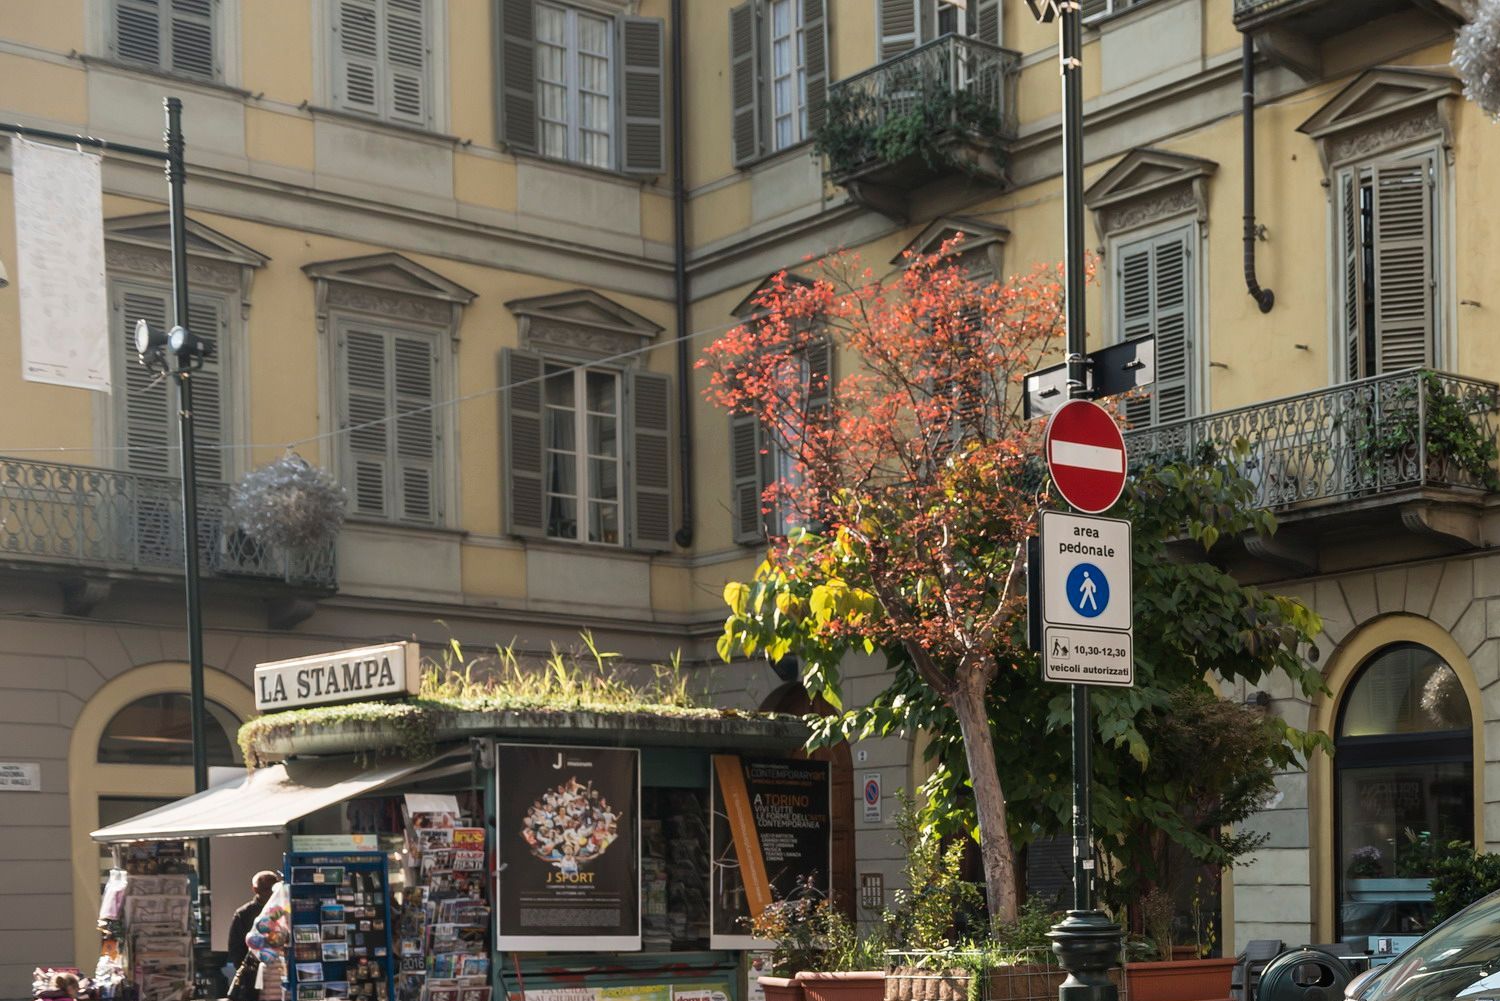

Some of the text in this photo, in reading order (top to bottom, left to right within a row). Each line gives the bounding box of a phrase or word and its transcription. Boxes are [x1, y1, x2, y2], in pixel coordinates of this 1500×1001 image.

[1073, 526, 1100, 538] area
[1059, 542, 1115, 558] pedonale
[1074, 645, 1126, 658] 10,30-12,30
[1050, 664, 1129, 676] veicoli autorizzati
[259, 657, 396, 703] LA STAMPA
[753, 793, 809, 808] A TORINO
[758, 820, 820, 829] CONTEMPORANEA
[546, 871, 595, 883] J SPORT
[402, 958, 425, 970] 2016
